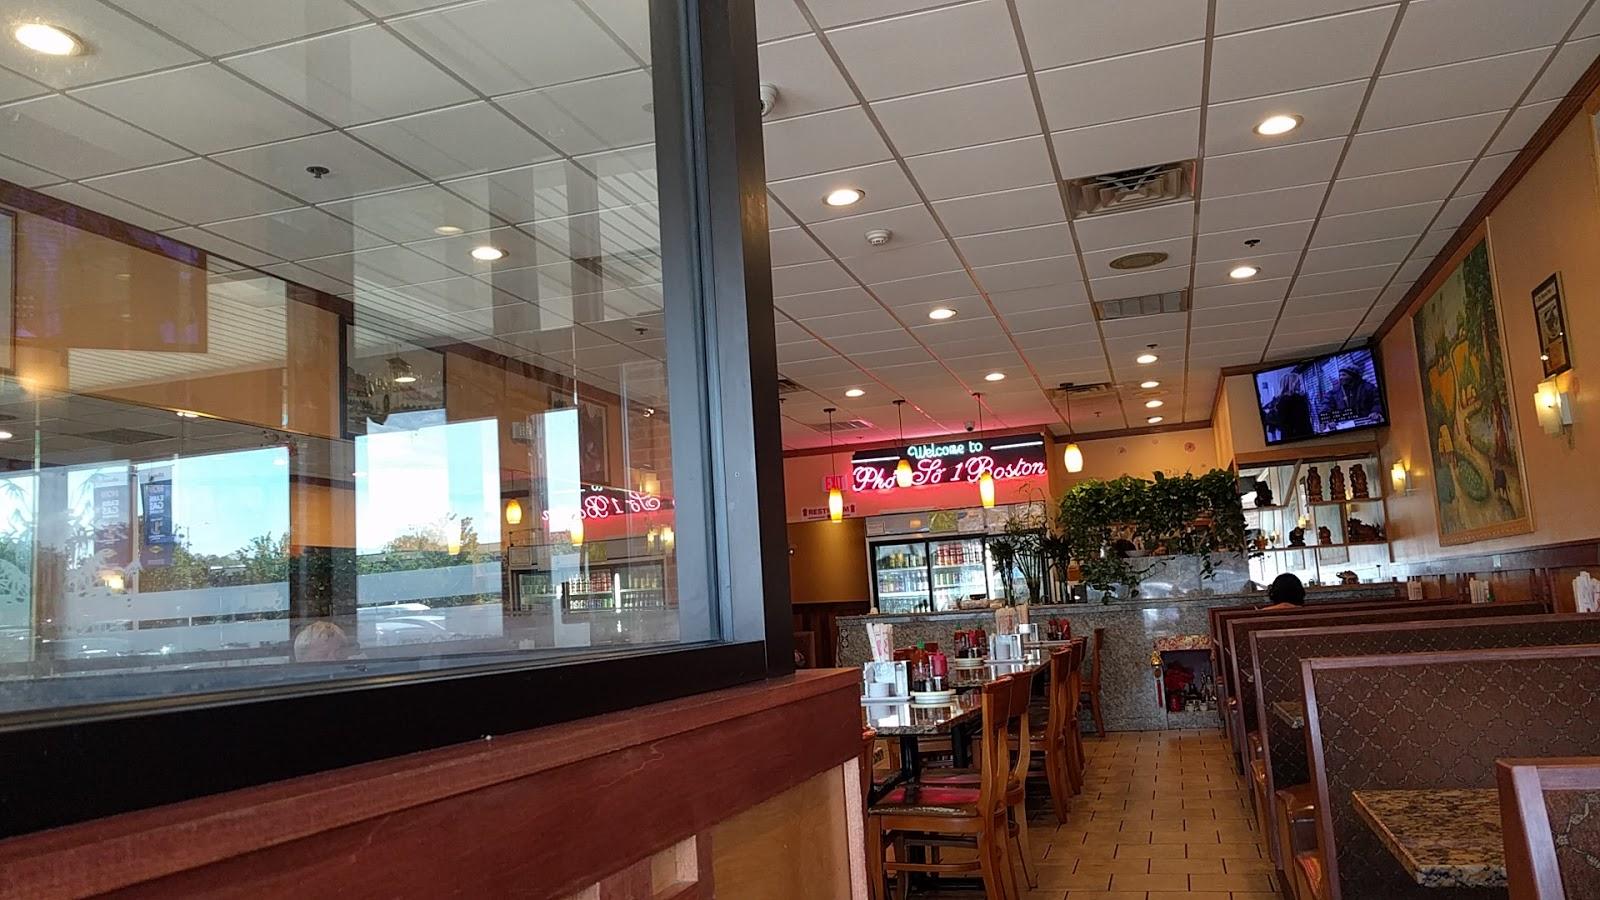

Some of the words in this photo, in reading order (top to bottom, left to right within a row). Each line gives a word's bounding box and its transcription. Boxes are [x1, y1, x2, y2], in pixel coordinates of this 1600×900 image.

[907, 443, 965, 459] Welcome
[968, 441, 983, 453] to
[949, 462, 964, 482] 1
[965, 455, 1046, 482] Boston
[825, 475, 844, 490] EXIT
[808, 506, 850, 516] RESTM
